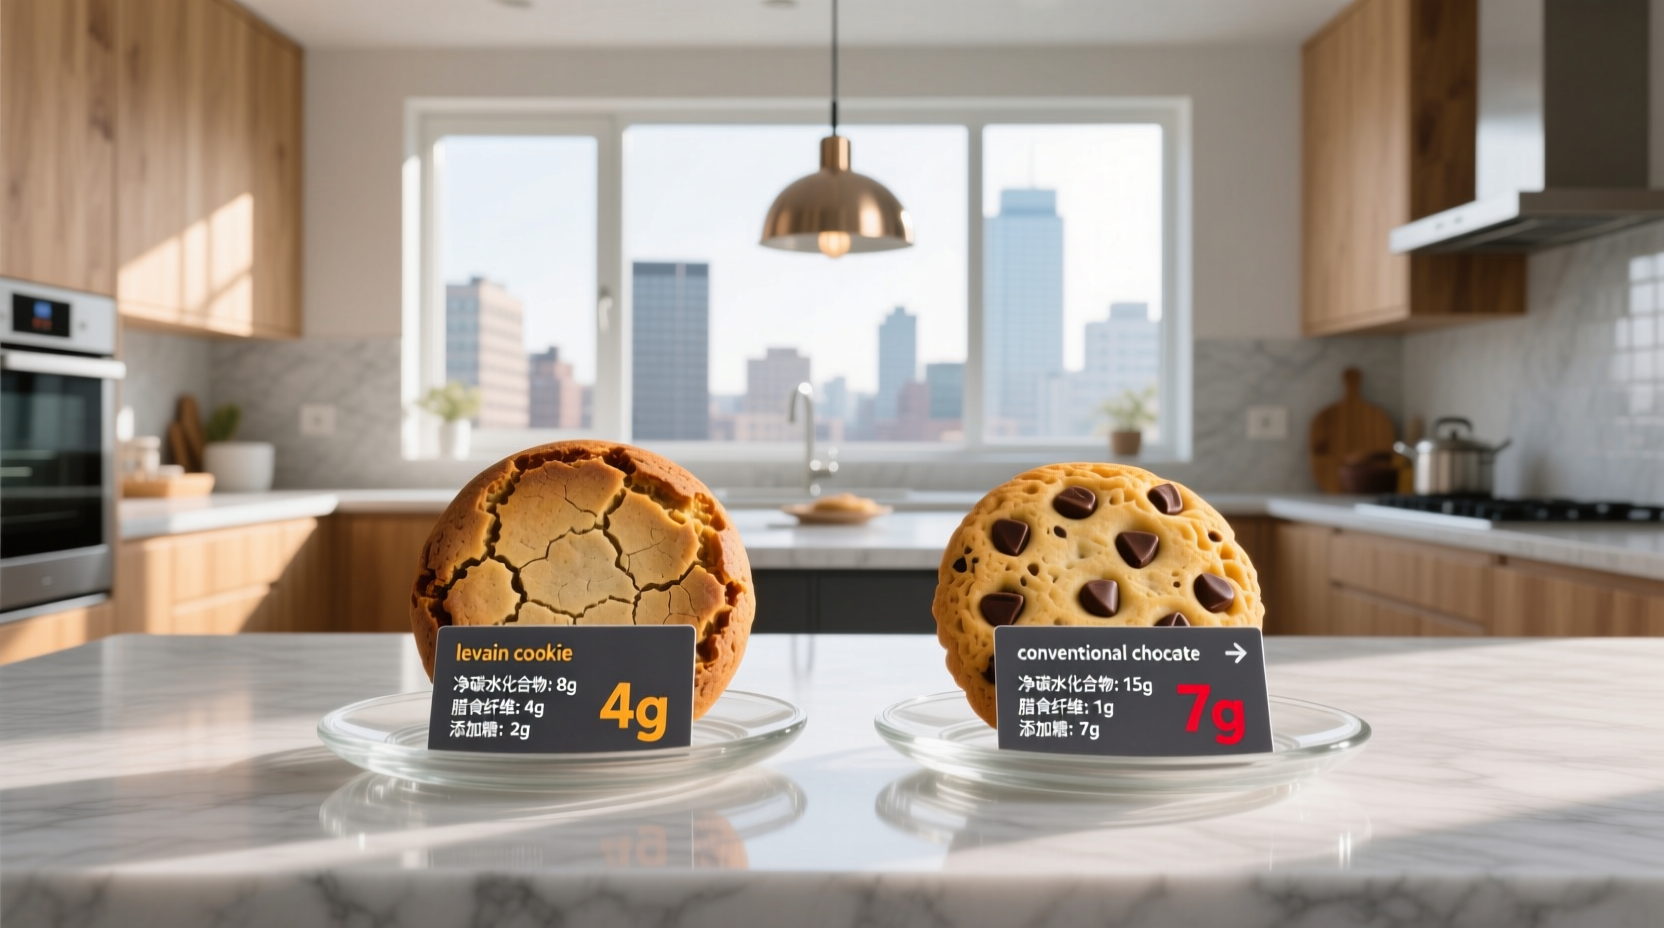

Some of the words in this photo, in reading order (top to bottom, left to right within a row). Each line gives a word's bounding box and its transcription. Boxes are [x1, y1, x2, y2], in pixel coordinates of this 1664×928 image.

[457, 643, 508, 661] levain
[514, 643, 572, 661] cookie
[1018, 644, 1127, 661] conventional
[1132, 644, 1200, 661] chocate
[557, 677, 577, 697] 8g
[1124, 677, 1152, 696] 15g
[524, 700, 544, 718] 4g
[600, 682, 667, 741] 4g
[1094, 700, 1114, 718] 1g
[1177, 684, 1245, 745] 7g
[510, 722, 530, 740] 2g
[1080, 721, 1100, 739] 7g
